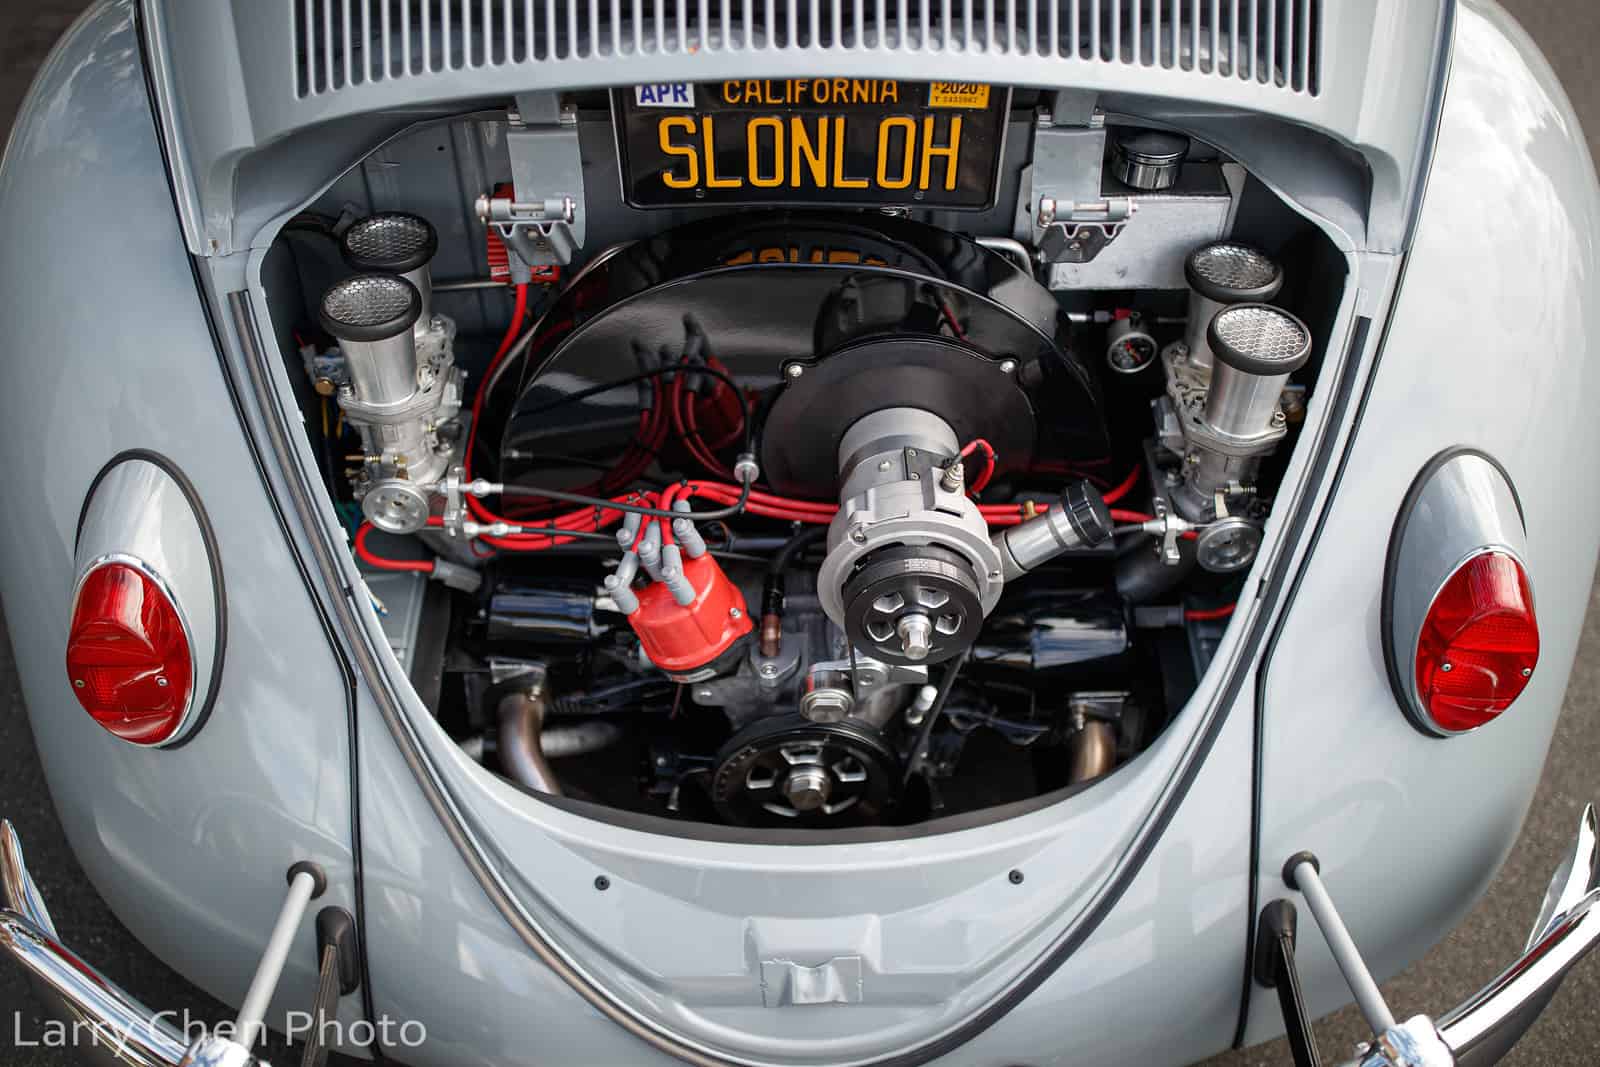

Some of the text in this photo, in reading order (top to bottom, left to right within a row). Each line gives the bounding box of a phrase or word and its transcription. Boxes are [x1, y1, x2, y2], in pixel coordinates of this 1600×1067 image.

[638, 83, 690, 104] APR
[722, 78, 899, 104] CALIFORNIA
[940, 81, 979, 94] 2020
[658, 116, 963, 191] SLONLOH
